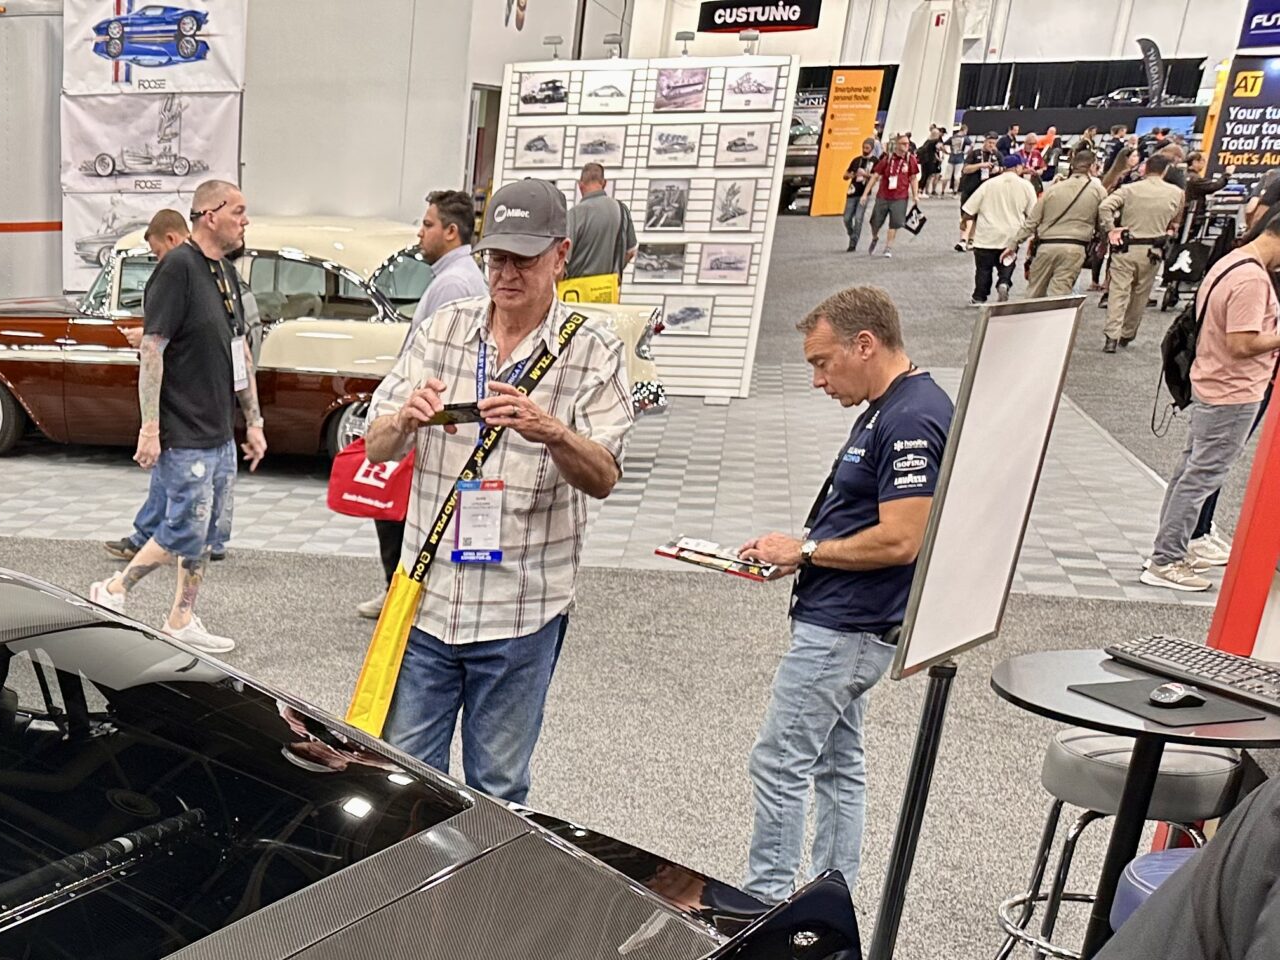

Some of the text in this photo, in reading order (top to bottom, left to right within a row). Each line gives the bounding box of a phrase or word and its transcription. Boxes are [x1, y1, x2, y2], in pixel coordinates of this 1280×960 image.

[138, 79, 166, 89] FOOSE
[1234, 76, 1264, 93] AT
[1229, 106, 1264, 120] Your
[1225, 121, 1260, 135] Your
[1221, 136, 1260, 150] Total
[1218, 152, 1260, 166] That's
[135, 180, 162, 189] FOOSE
[557, 322, 576, 347] QUA
